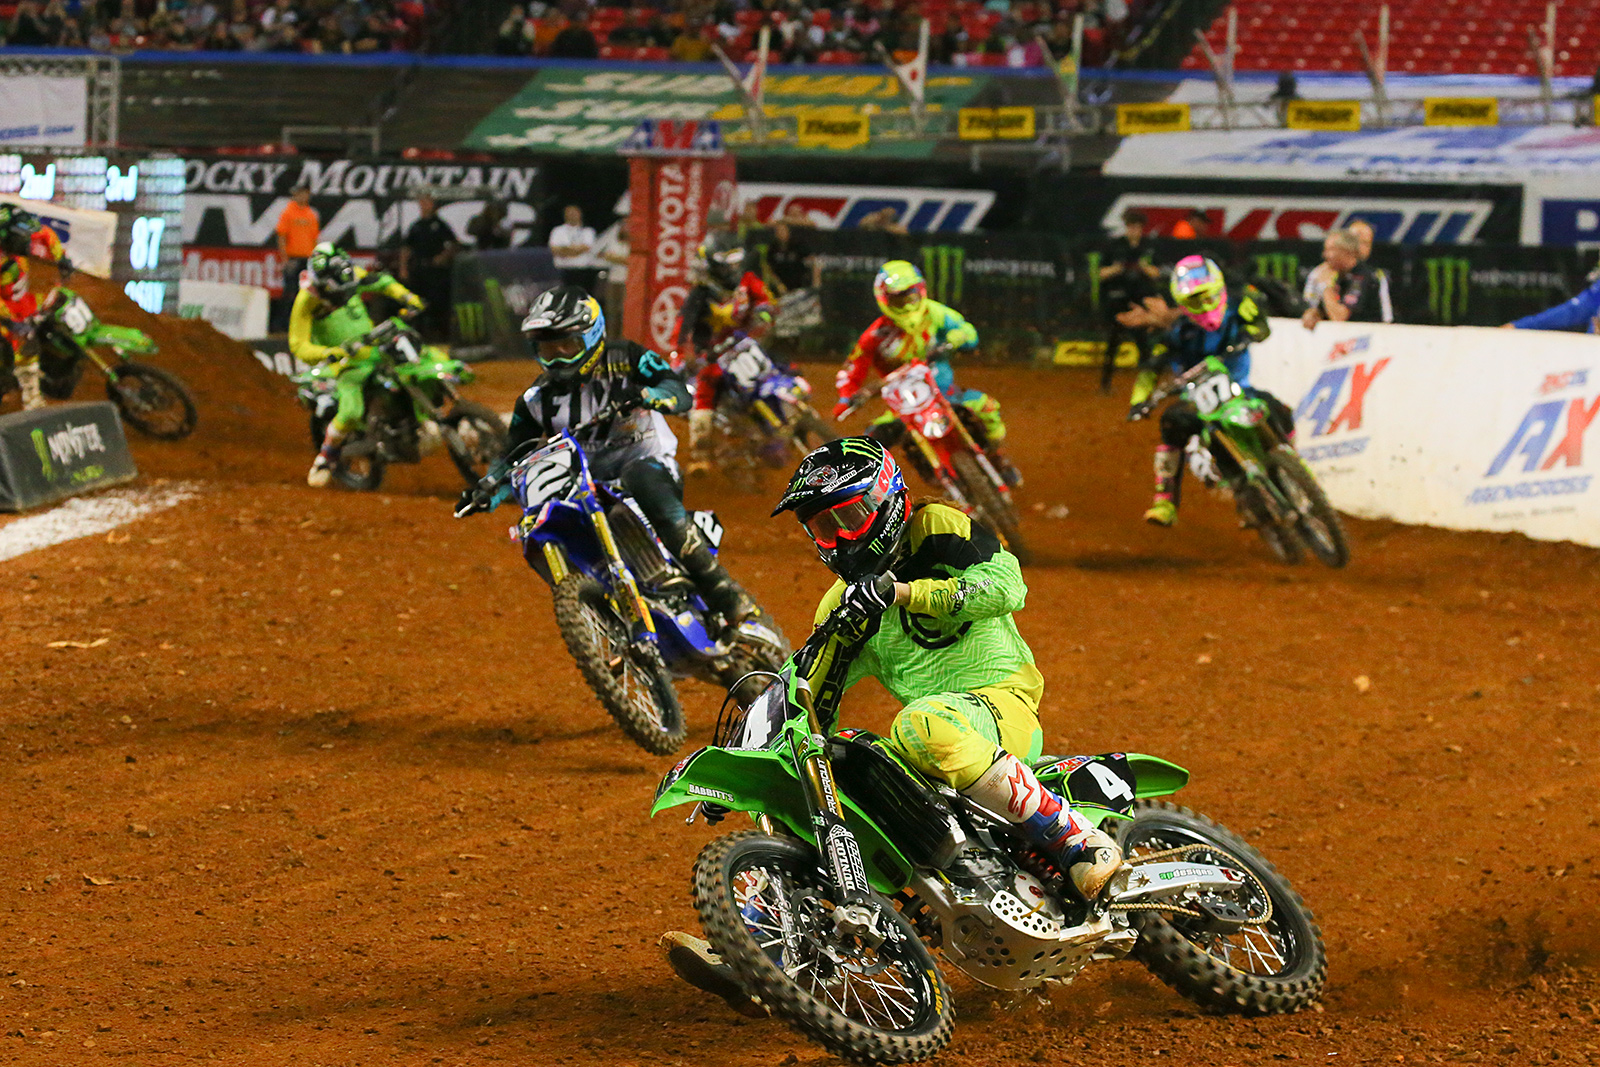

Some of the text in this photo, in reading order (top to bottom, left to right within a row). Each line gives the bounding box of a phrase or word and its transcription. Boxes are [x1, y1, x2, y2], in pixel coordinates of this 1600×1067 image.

[130, 216, 166, 270] 87
[655, 163, 684, 282] TOYOTA
[525, 450, 574, 508] 2
[692, 509, 725, 548] 2
[687, 782, 735, 802] BABBITT'S
[1085, 761, 1135, 802] 4
[834, 838, 856, 891] DUNLOP
